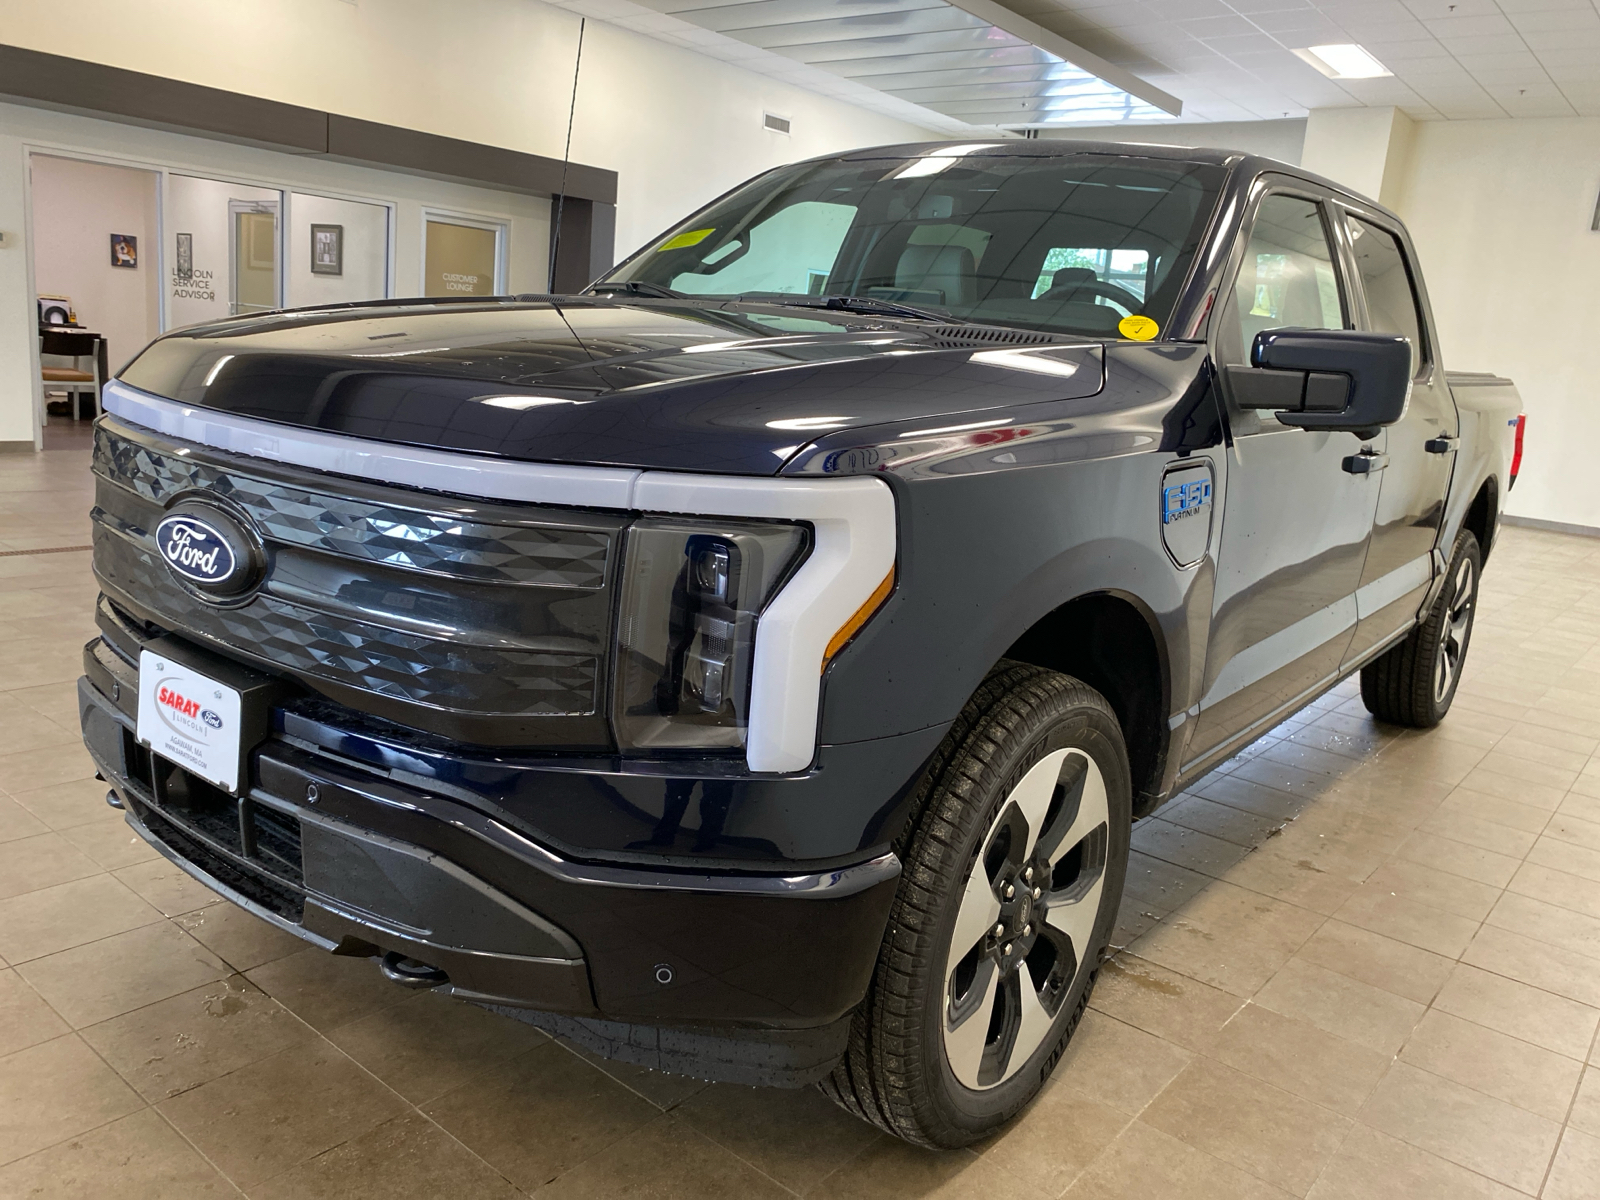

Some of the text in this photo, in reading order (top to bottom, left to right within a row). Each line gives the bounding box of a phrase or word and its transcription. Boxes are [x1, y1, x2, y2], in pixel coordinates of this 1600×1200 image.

[172, 267, 213, 279] LINCOLN
[442, 273, 478, 283] CUSTOMER
[172, 277, 210, 290] SERVICE
[446, 282, 474, 292] LOUNGE
[173, 289, 215, 301] ADVISOR
[1169, 505, 1201, 523] PLATINUM
[167, 524, 219, 574] Ford
[158, 686, 200, 719] SARAT
[175, 713, 204, 734] LINCOLN
[204, 710, 221, 728] Ford
[170, 735, 203, 759] AGAWAM, MA
